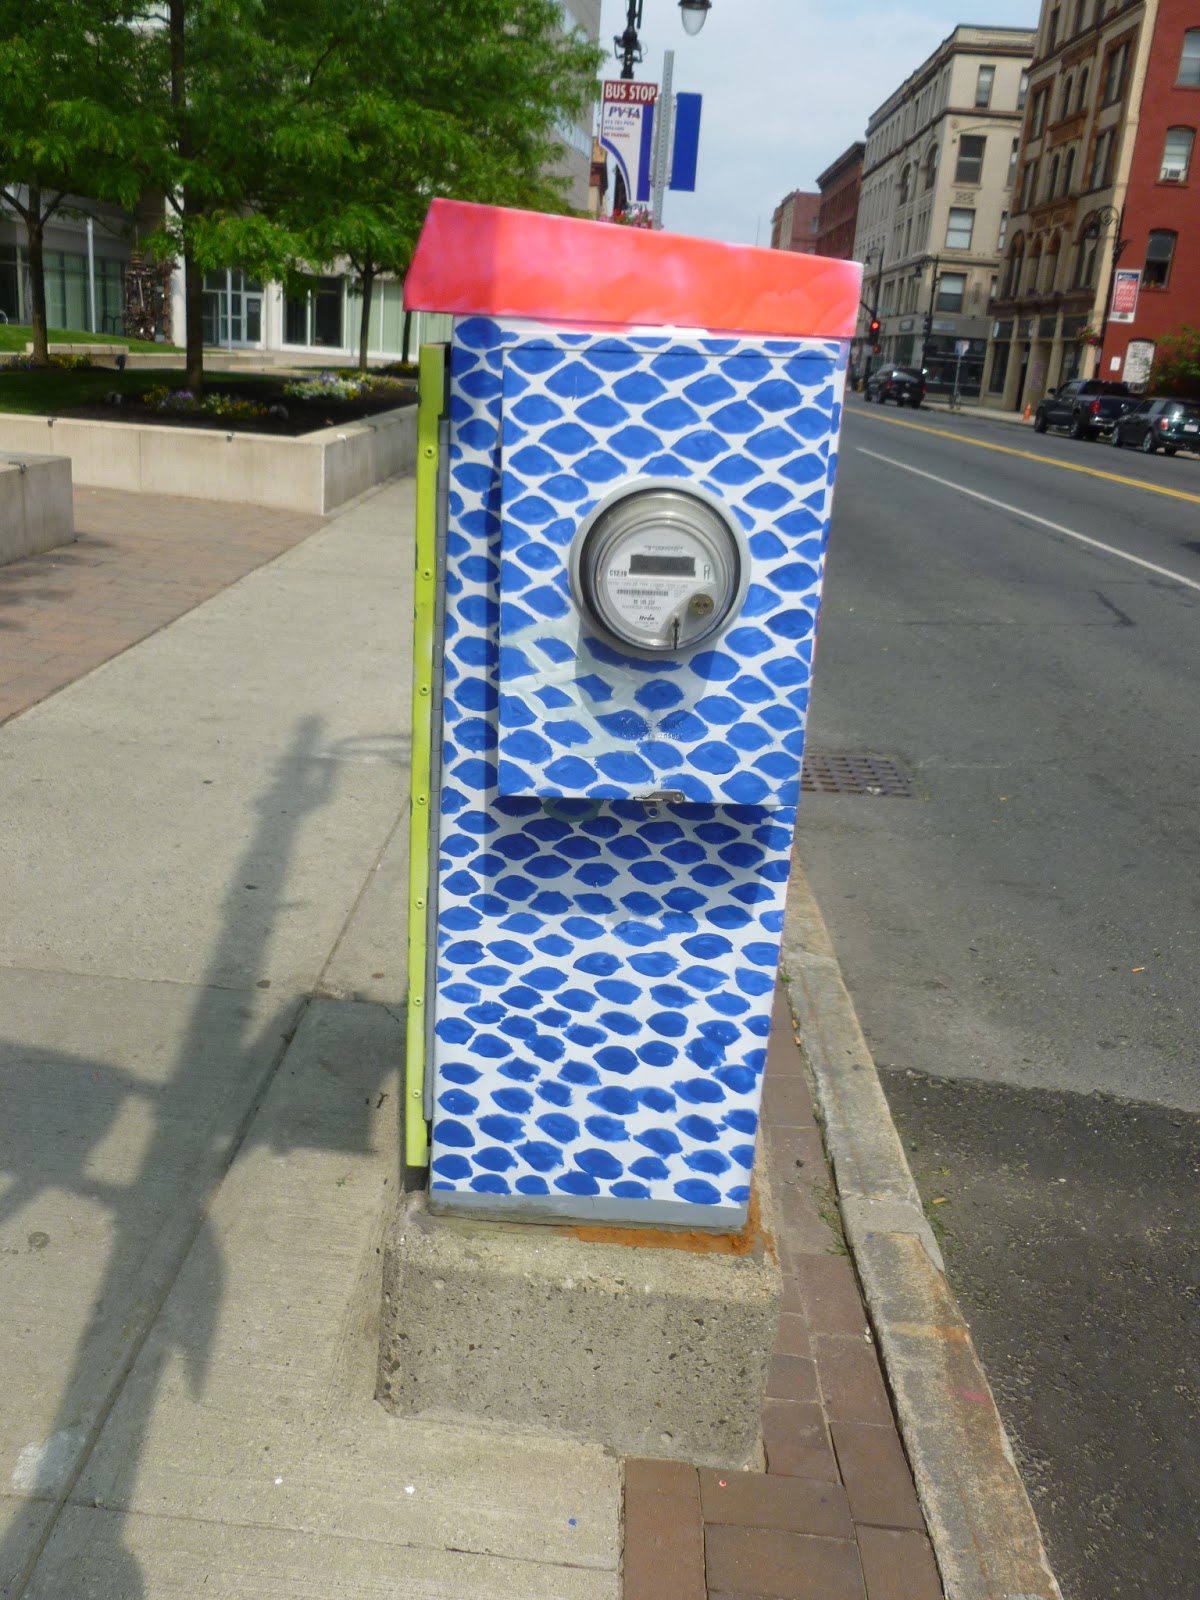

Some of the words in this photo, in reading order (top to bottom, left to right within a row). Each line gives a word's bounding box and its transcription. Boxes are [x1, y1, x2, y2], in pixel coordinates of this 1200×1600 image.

[605, 83, 626, 100] BUS
[629, 84, 656, 101] STOP
[608, 106, 640, 119] PVTA
